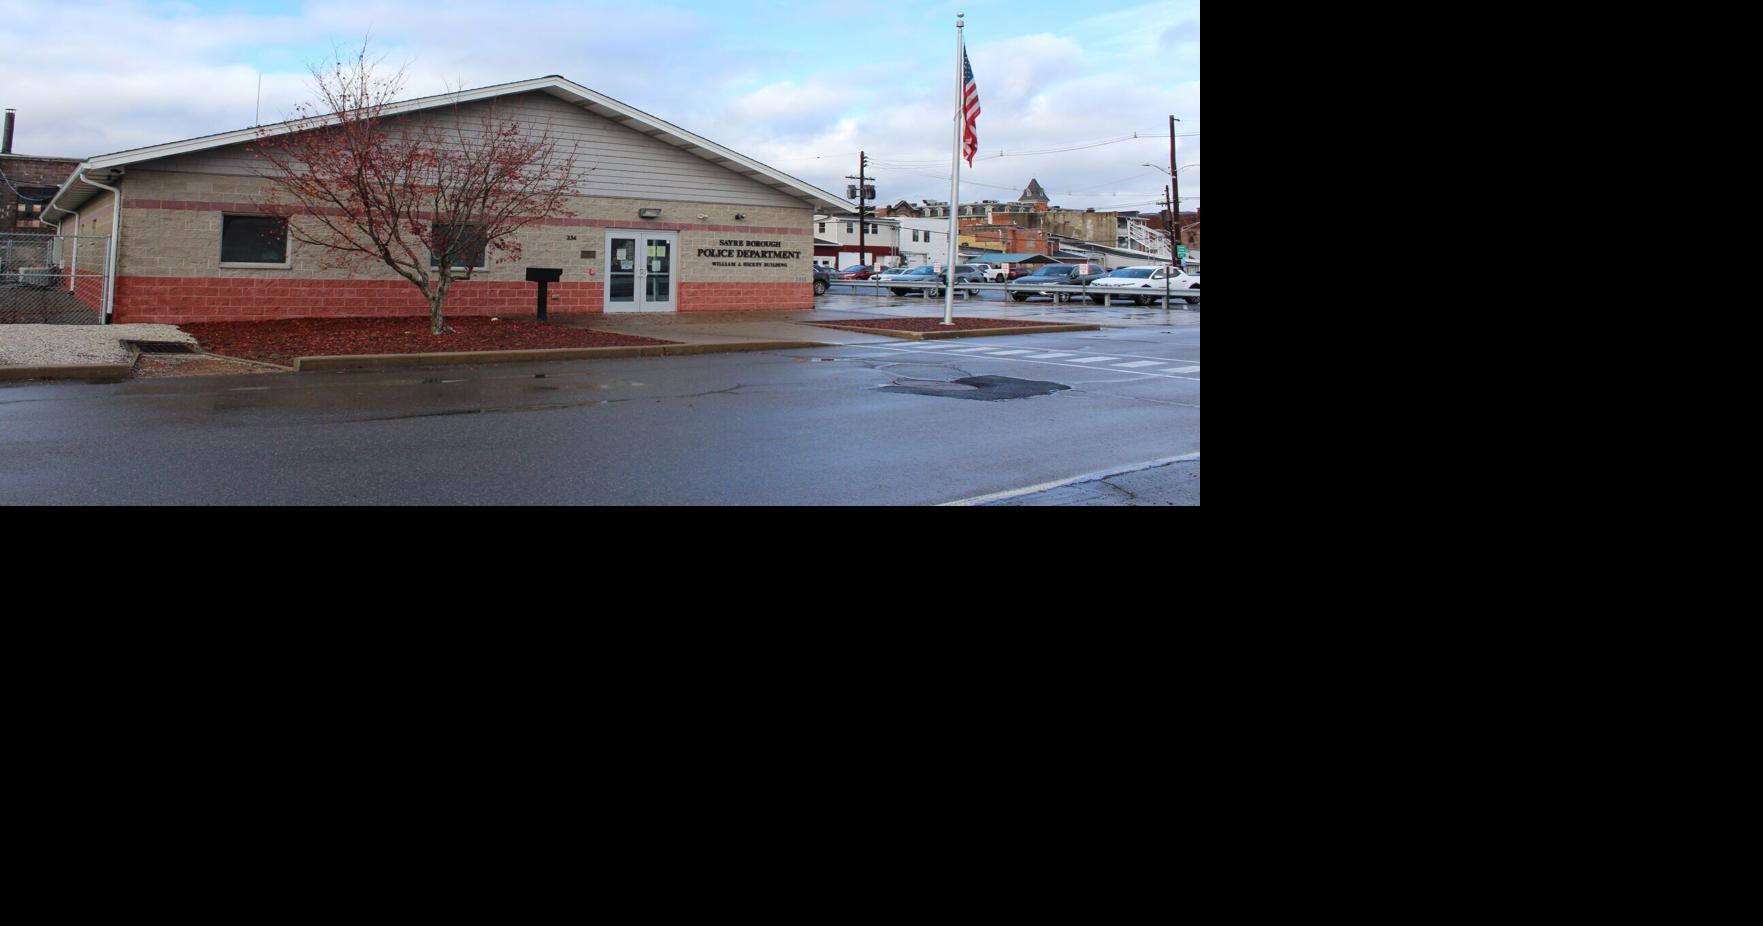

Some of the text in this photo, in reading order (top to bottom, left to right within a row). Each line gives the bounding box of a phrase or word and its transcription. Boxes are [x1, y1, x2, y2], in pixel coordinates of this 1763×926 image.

[719, 239, 781, 248] SAYRE BOROUGH
[697, 248, 801, 260] POLICE DEPARTMENT
